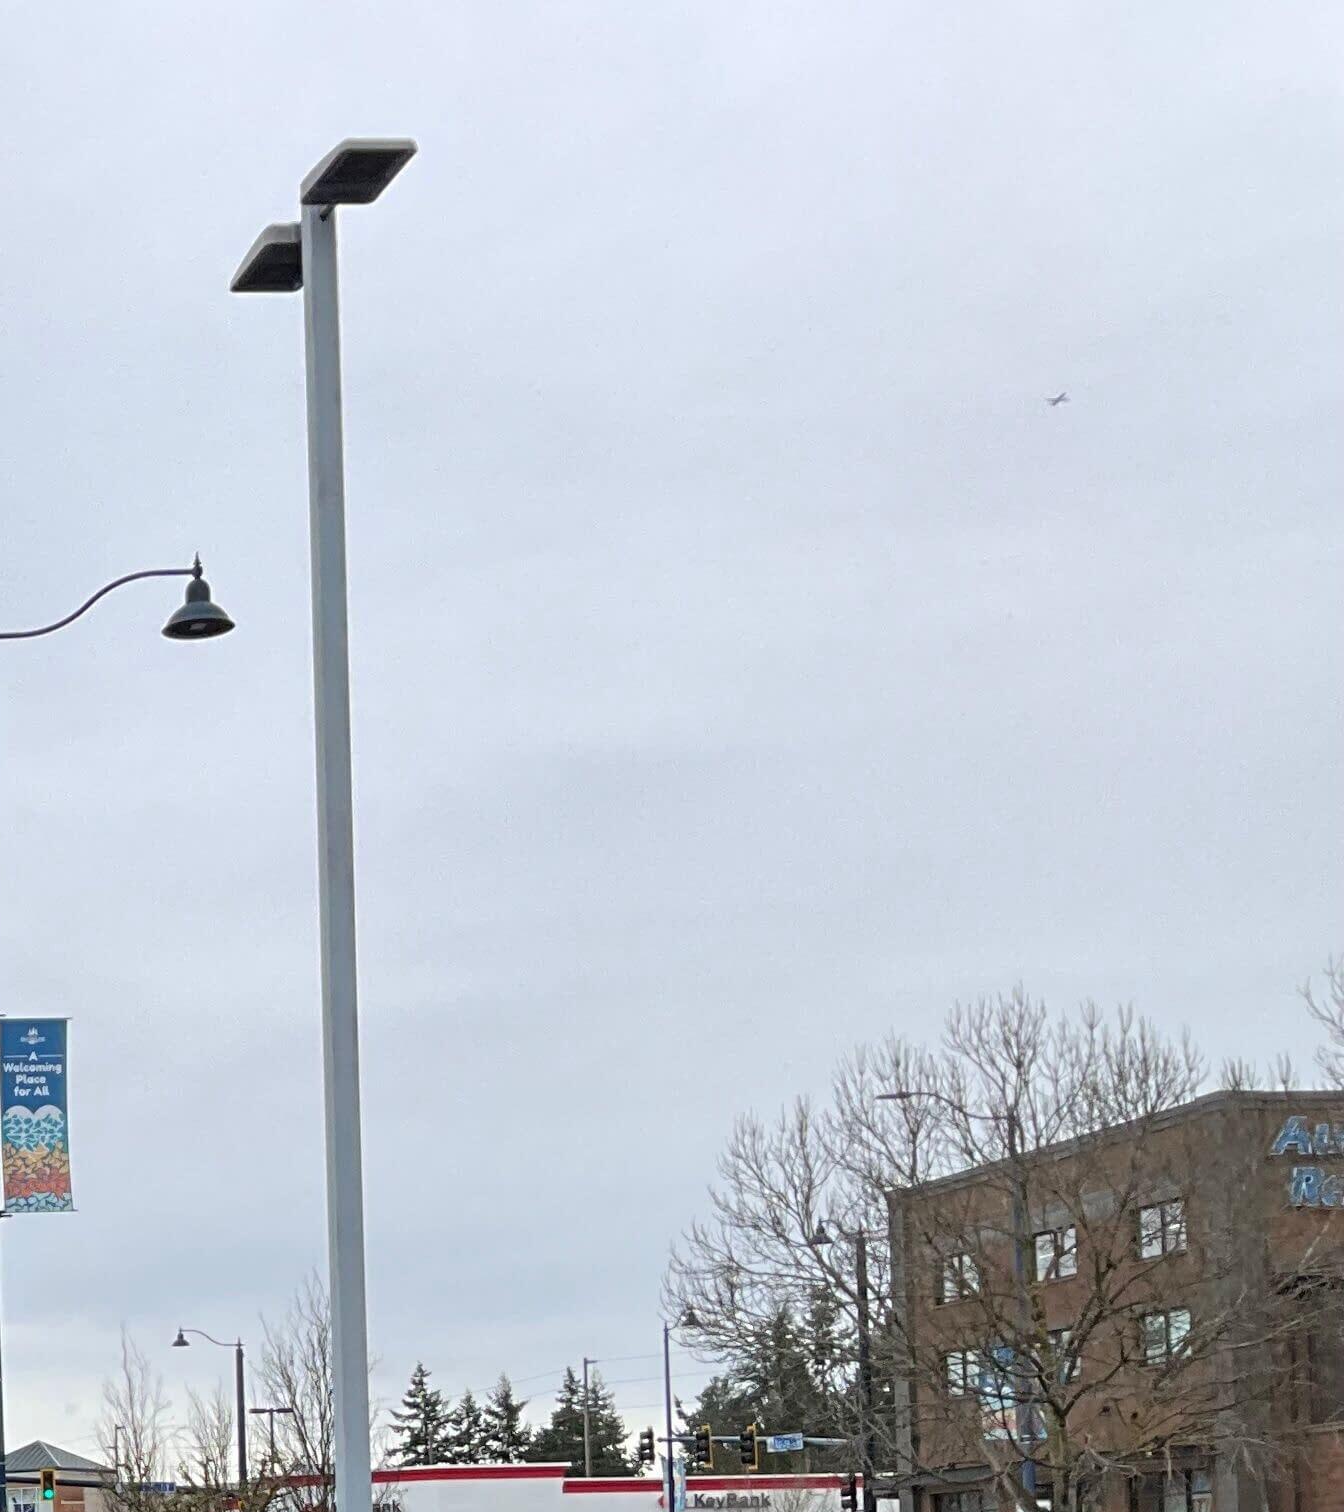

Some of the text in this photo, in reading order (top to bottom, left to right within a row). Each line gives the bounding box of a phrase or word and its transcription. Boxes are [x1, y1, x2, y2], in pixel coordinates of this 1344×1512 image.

[28, 1050, 38, 1062] A
[2, 1062, 62, 1075] Welcoming
[15, 1073, 47, 1084] Place
[14, 1085, 50, 1097] for All
[693, 1492, 772, 1510] KeyBank
